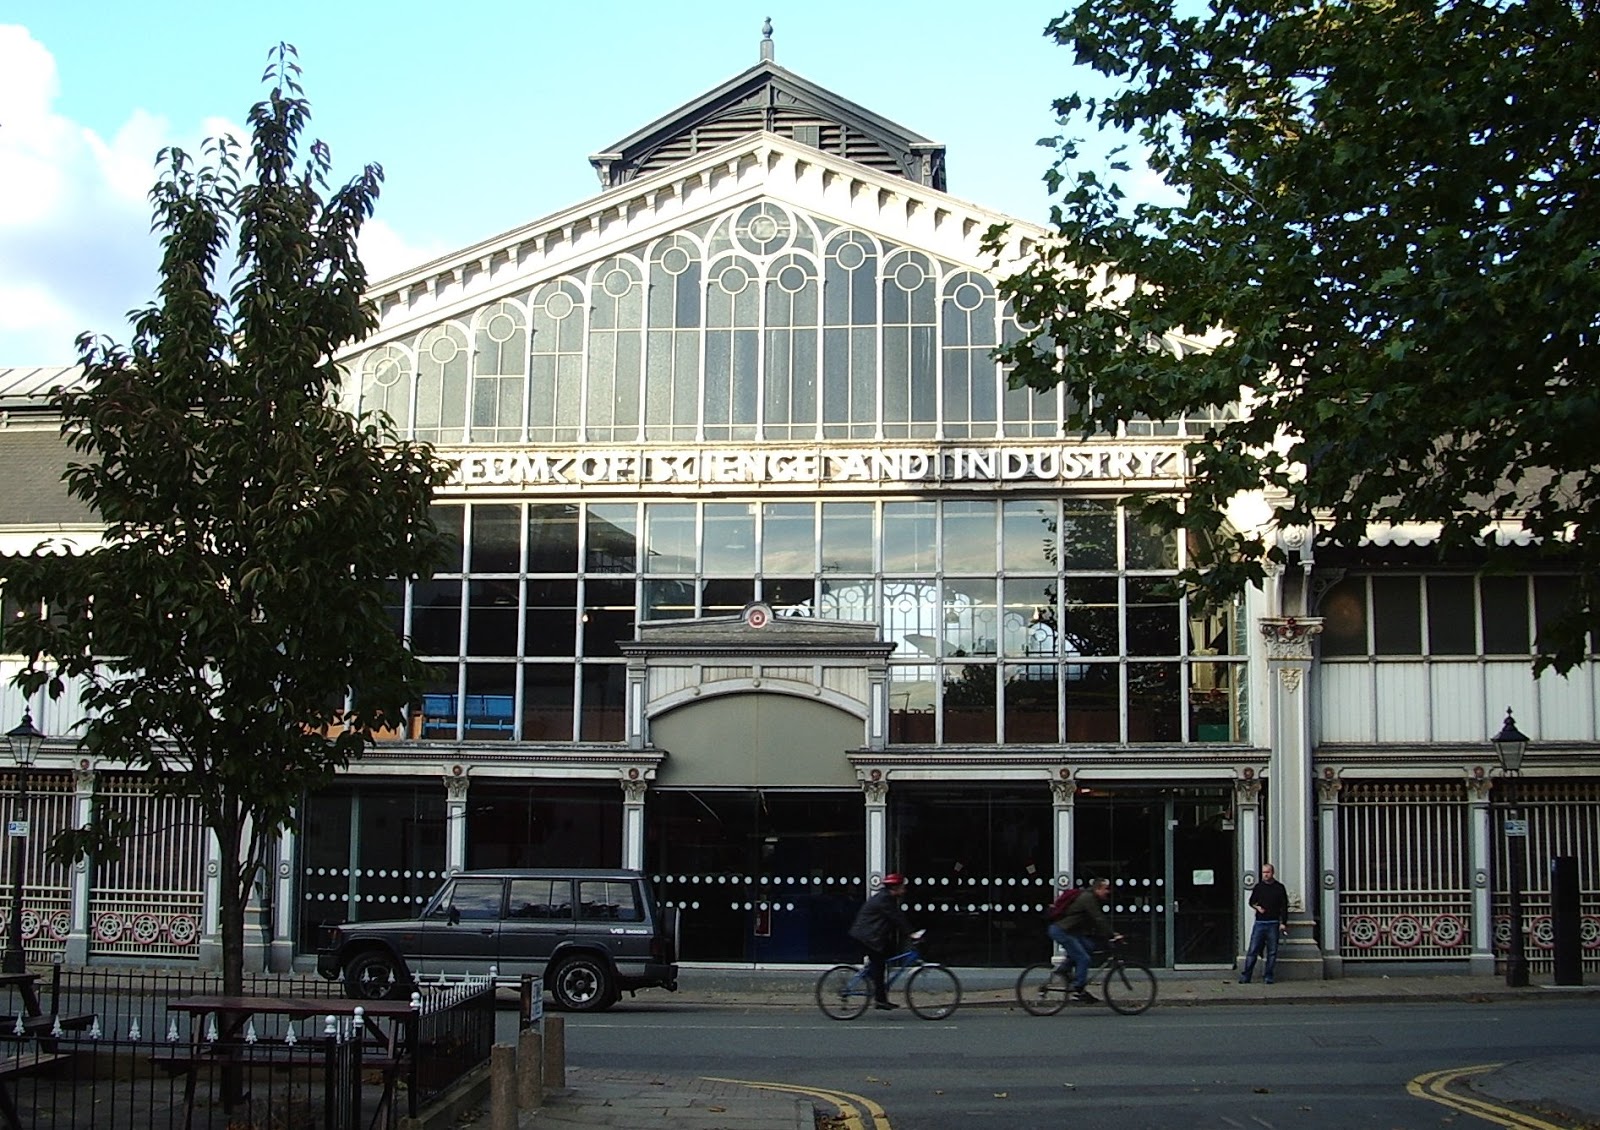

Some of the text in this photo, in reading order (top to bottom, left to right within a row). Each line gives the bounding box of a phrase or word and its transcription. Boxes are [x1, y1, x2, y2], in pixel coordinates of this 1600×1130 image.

[574, 451, 630, 482] OF
[650, 450, 817, 482] SCIENCE
[835, 448, 929, 481] AND
[954, 447, 1162, 480] INDUSTRY
